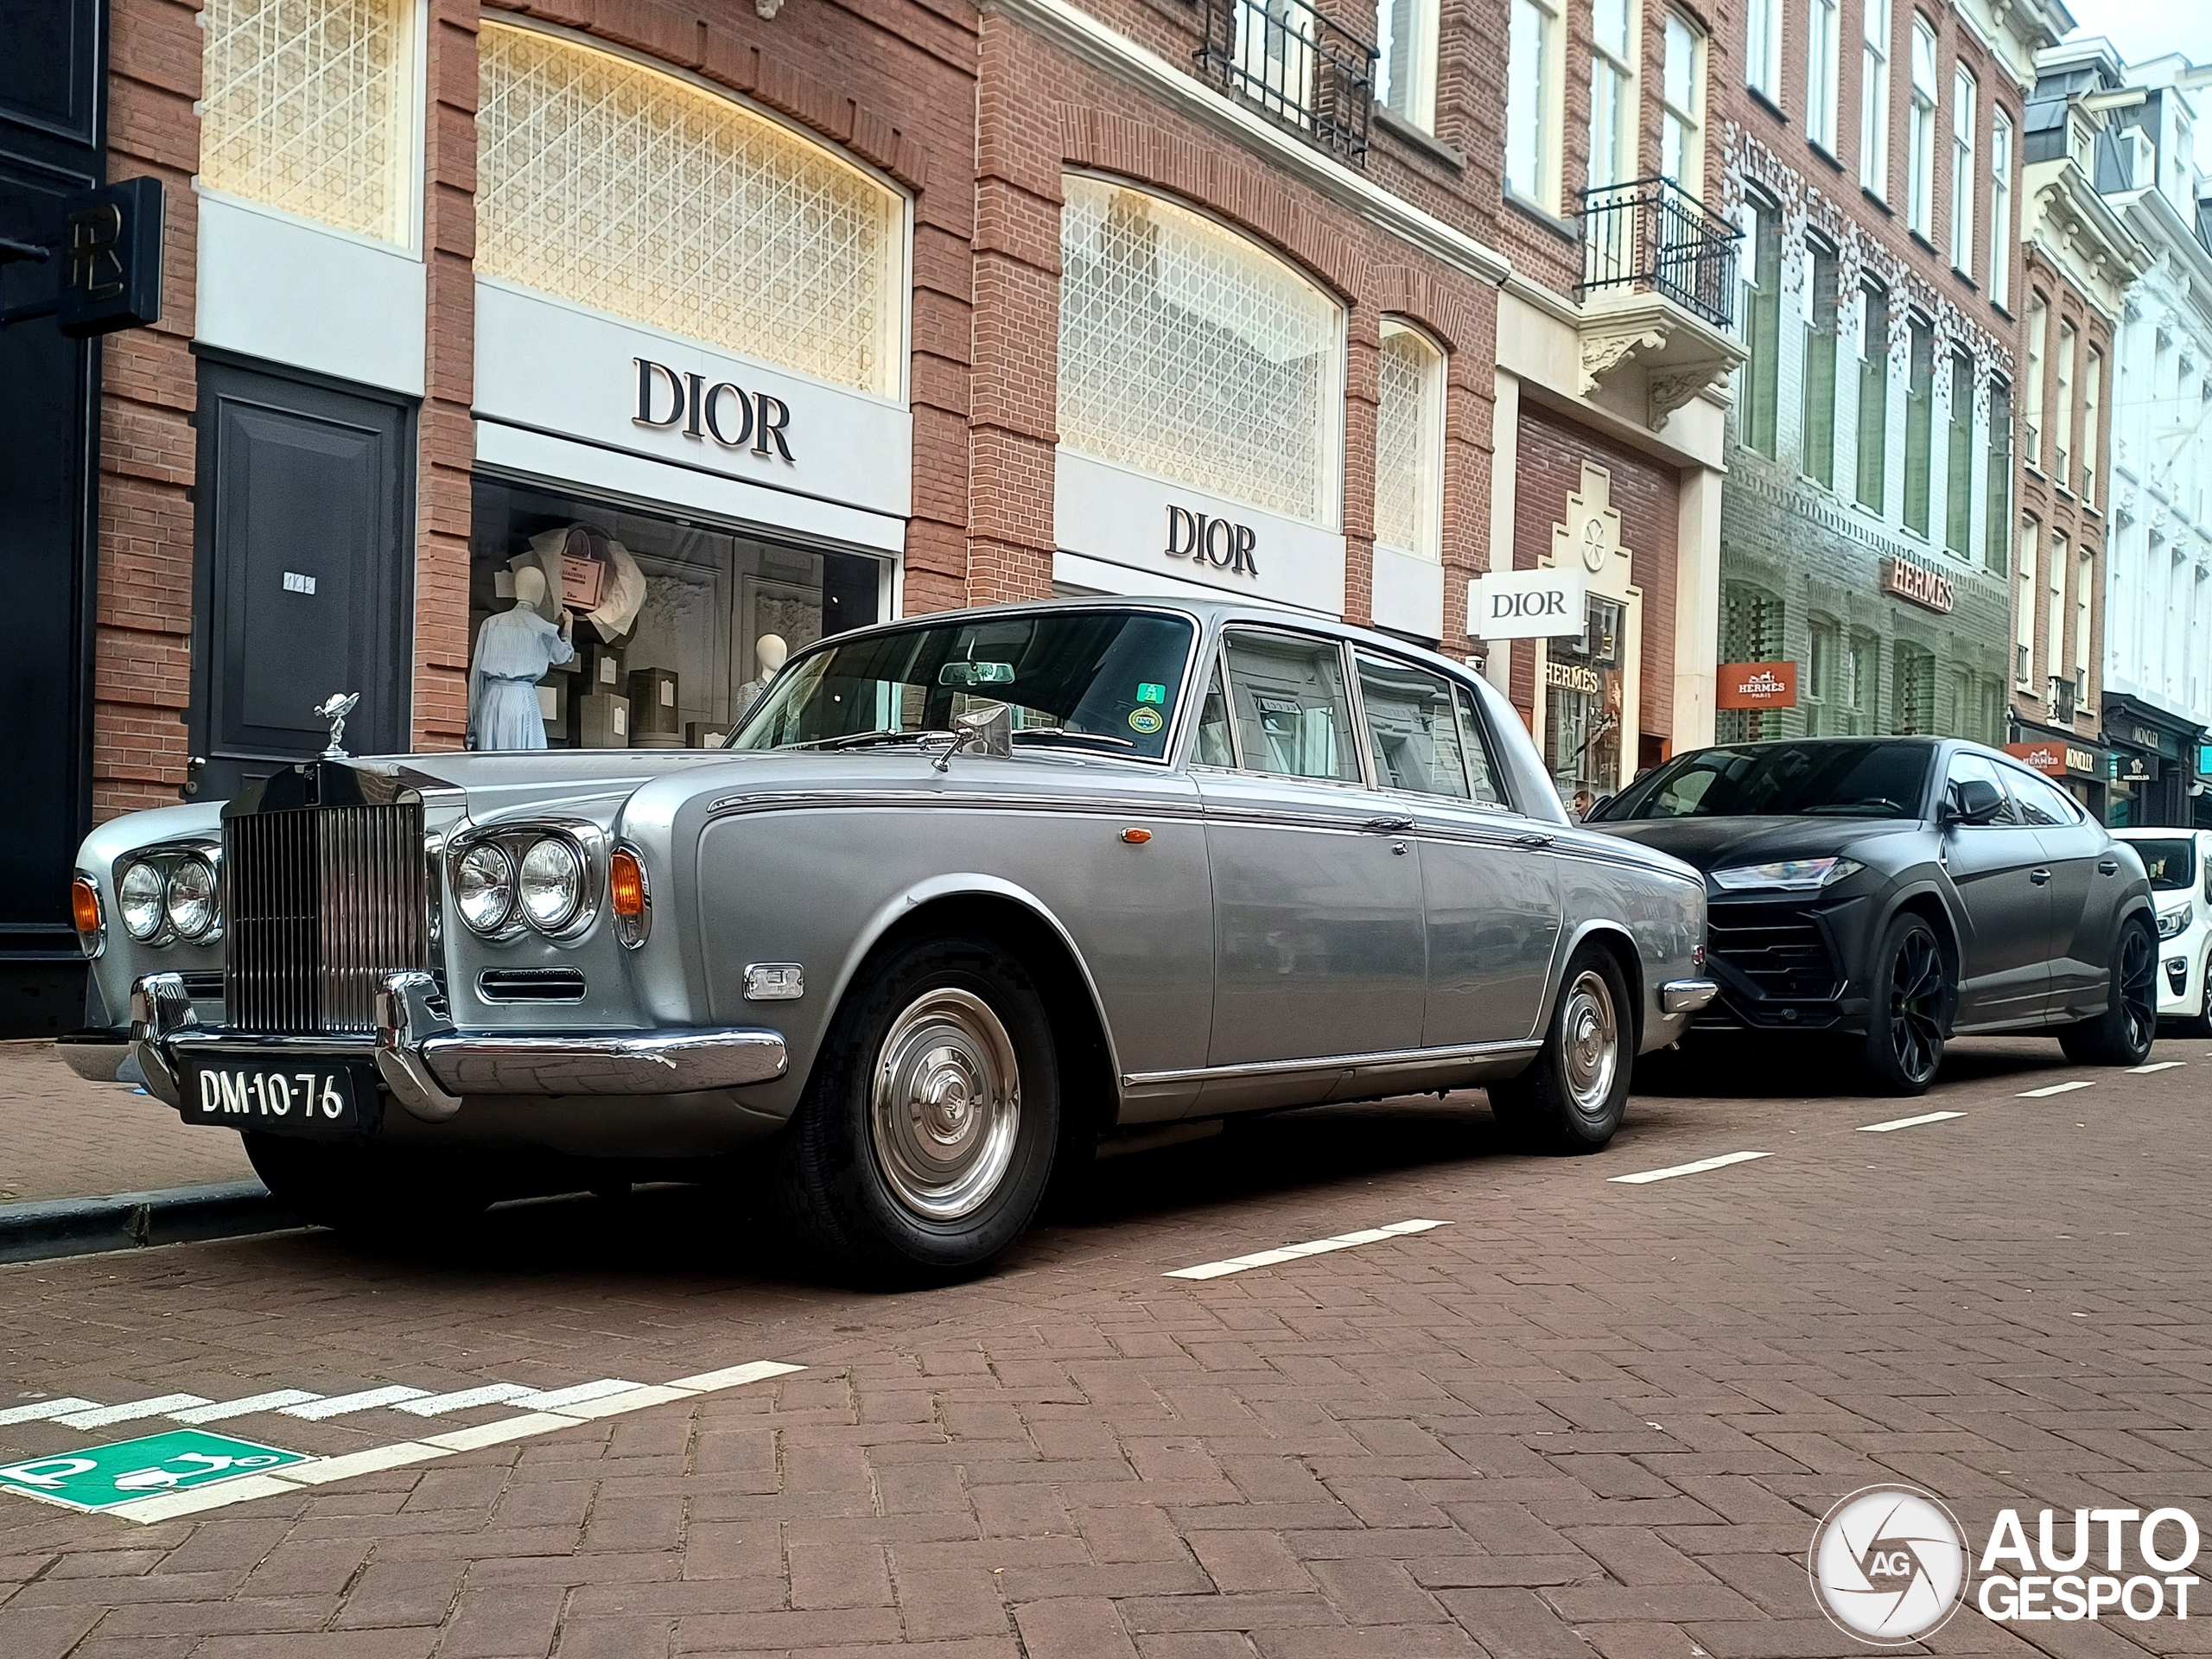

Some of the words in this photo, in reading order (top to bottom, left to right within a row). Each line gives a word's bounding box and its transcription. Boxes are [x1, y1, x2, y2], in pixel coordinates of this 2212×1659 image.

[632, 357, 796, 462] DIOR
[1165, 504, 1259, 575] DIOR
[1491, 590, 1567, 619] DIOR
[200, 1070, 344, 1119] DM-10-76
